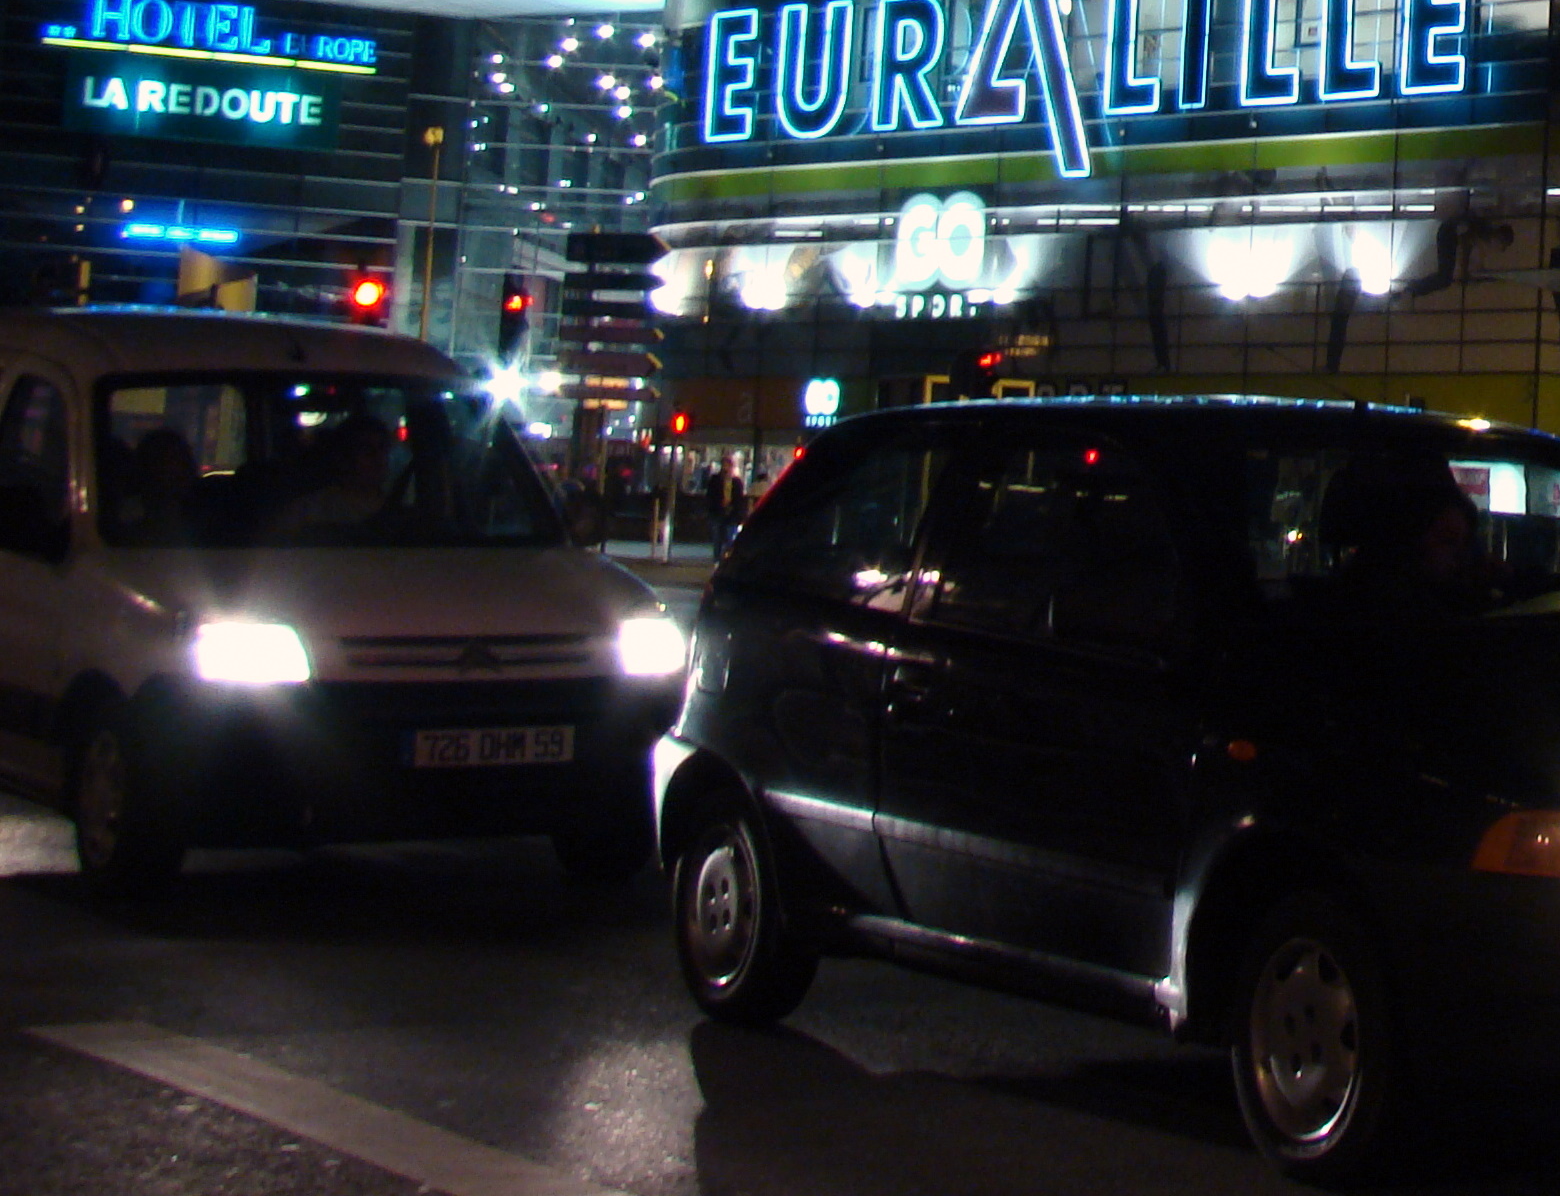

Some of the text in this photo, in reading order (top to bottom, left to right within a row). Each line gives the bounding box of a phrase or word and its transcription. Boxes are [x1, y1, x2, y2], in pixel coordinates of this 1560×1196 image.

[83, 75, 323, 126] LA REDOUTE
[897, 196, 985, 288] GO
[423, 732, 471, 762] 726
[534, 727, 564, 757] 59
